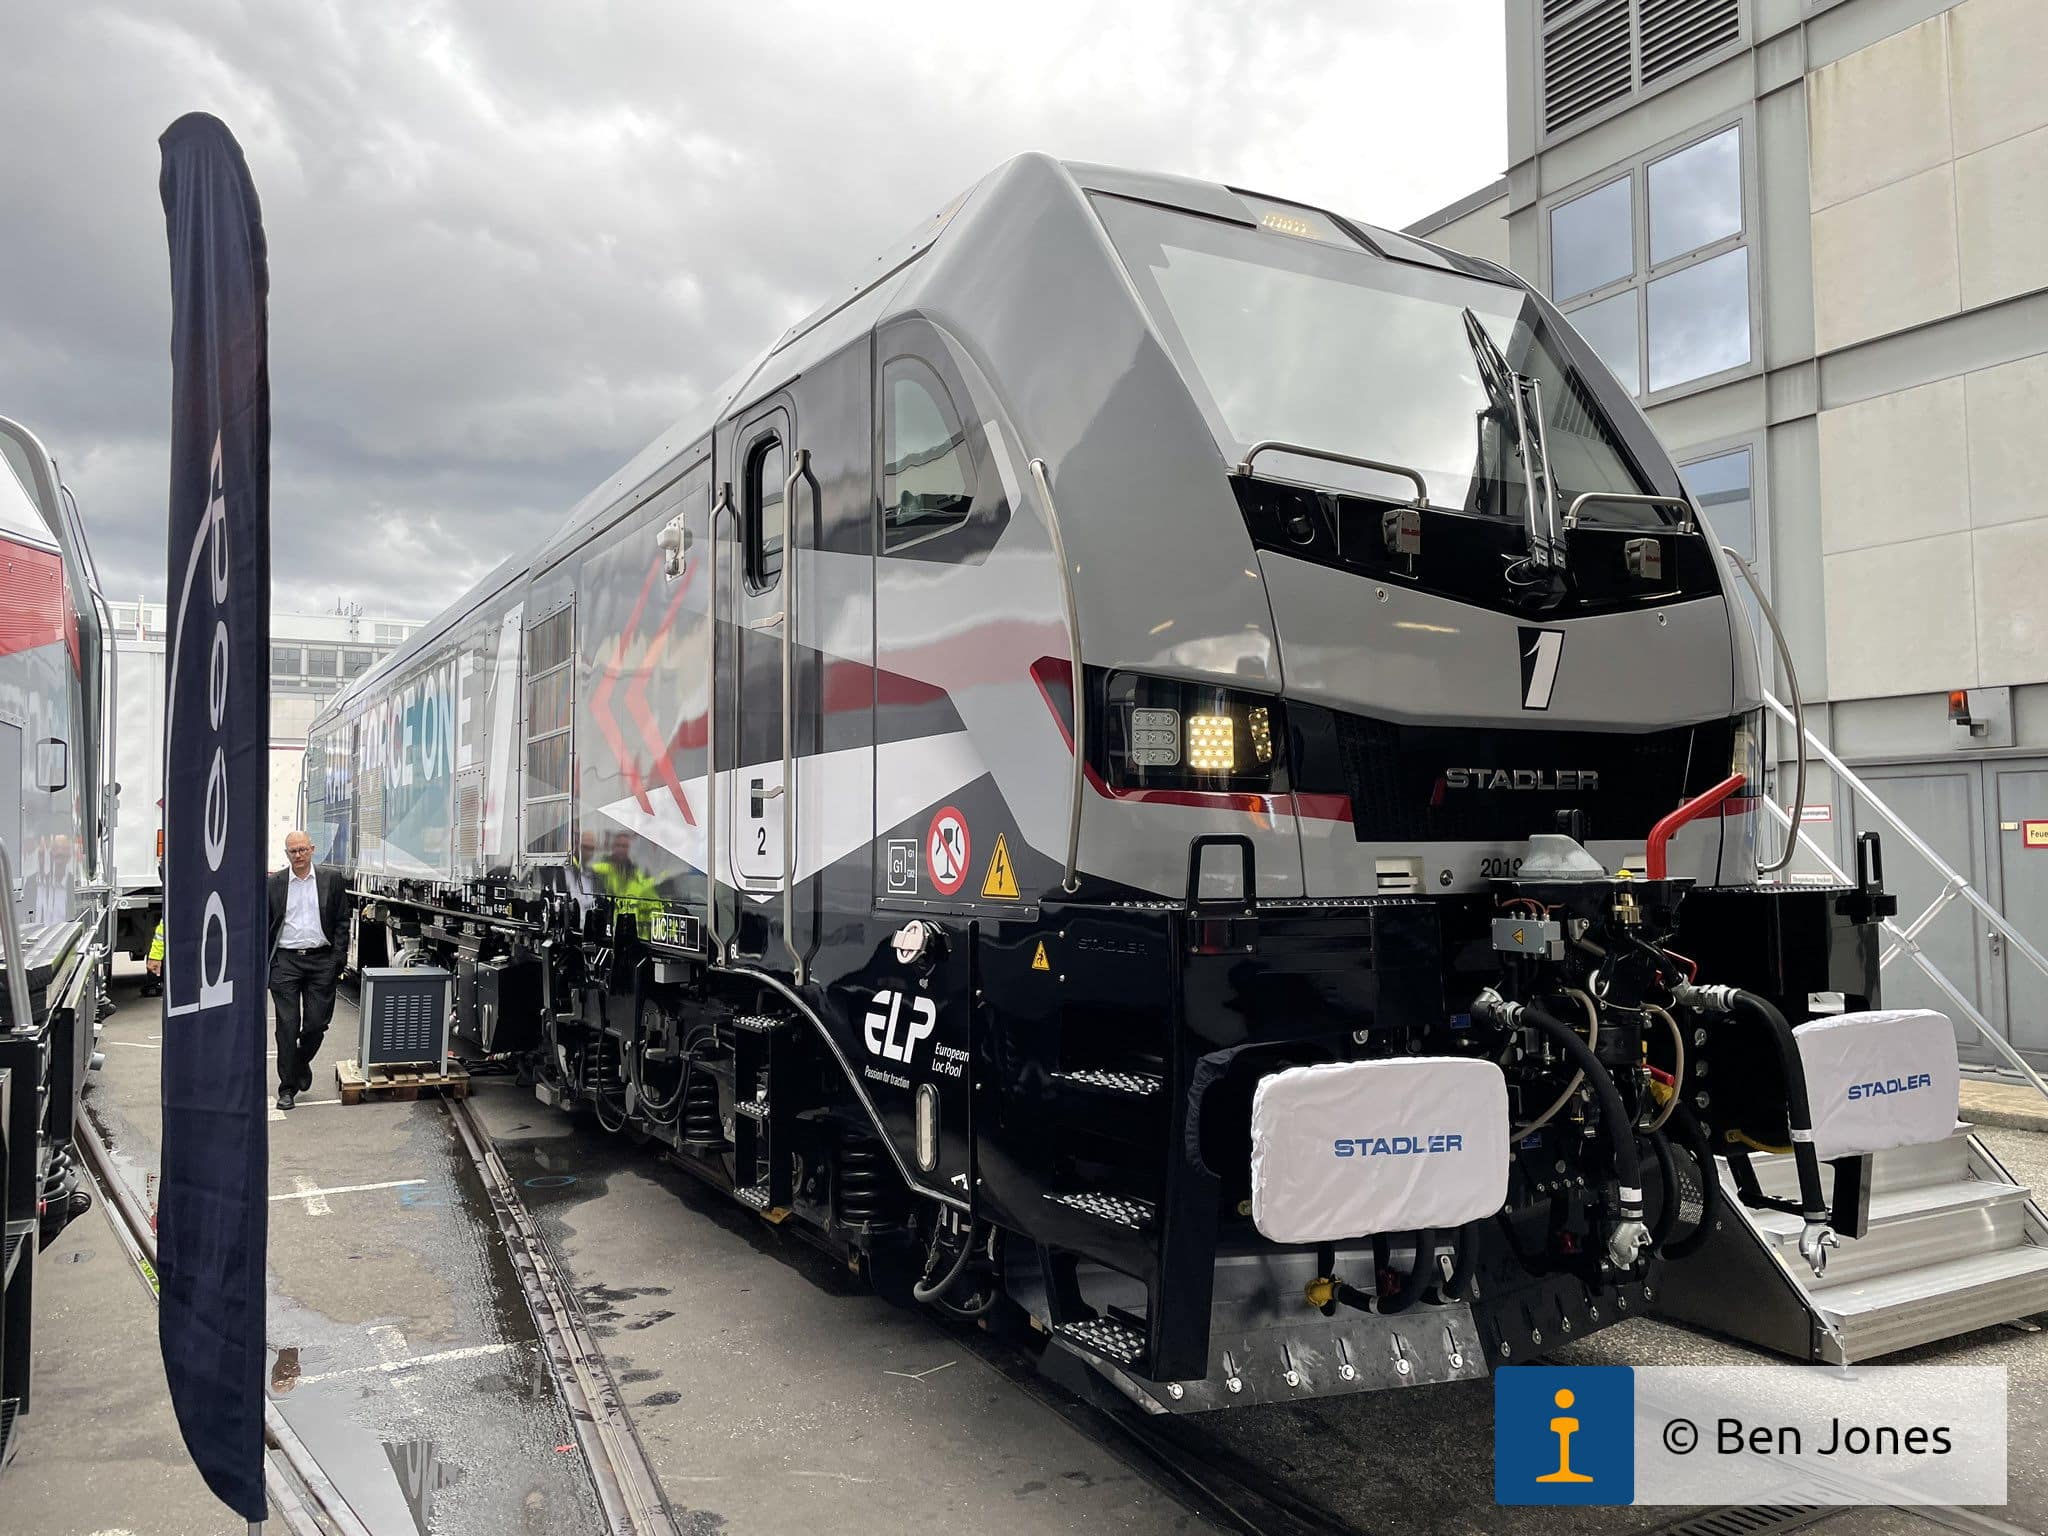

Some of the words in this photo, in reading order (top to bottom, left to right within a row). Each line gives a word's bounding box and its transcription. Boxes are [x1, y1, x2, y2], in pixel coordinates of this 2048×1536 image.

[1523, 631, 1563, 708] 1
[359, 685, 415, 790] FORCE
[421, 650, 474, 782] ONE
[200, 488, 233, 1010] pesa
[1446, 767, 1599, 790] STADLER
[757, 826, 766, 856] 2
[893, 859, 904, 874] G1
[652, 916, 667, 941] UIC
[864, 989, 937, 1065] ELP
[934, 1041, 970, 1063] European
[864, 1064, 884, 1082] Passion
[889, 1072, 910, 1090] traction
[931, 1057, 945, 1074] Loc
[944, 1060, 963, 1079] Pool
[1848, 1073, 1932, 1101] STADLER
[1334, 1134, 1462, 1158] STADLER
